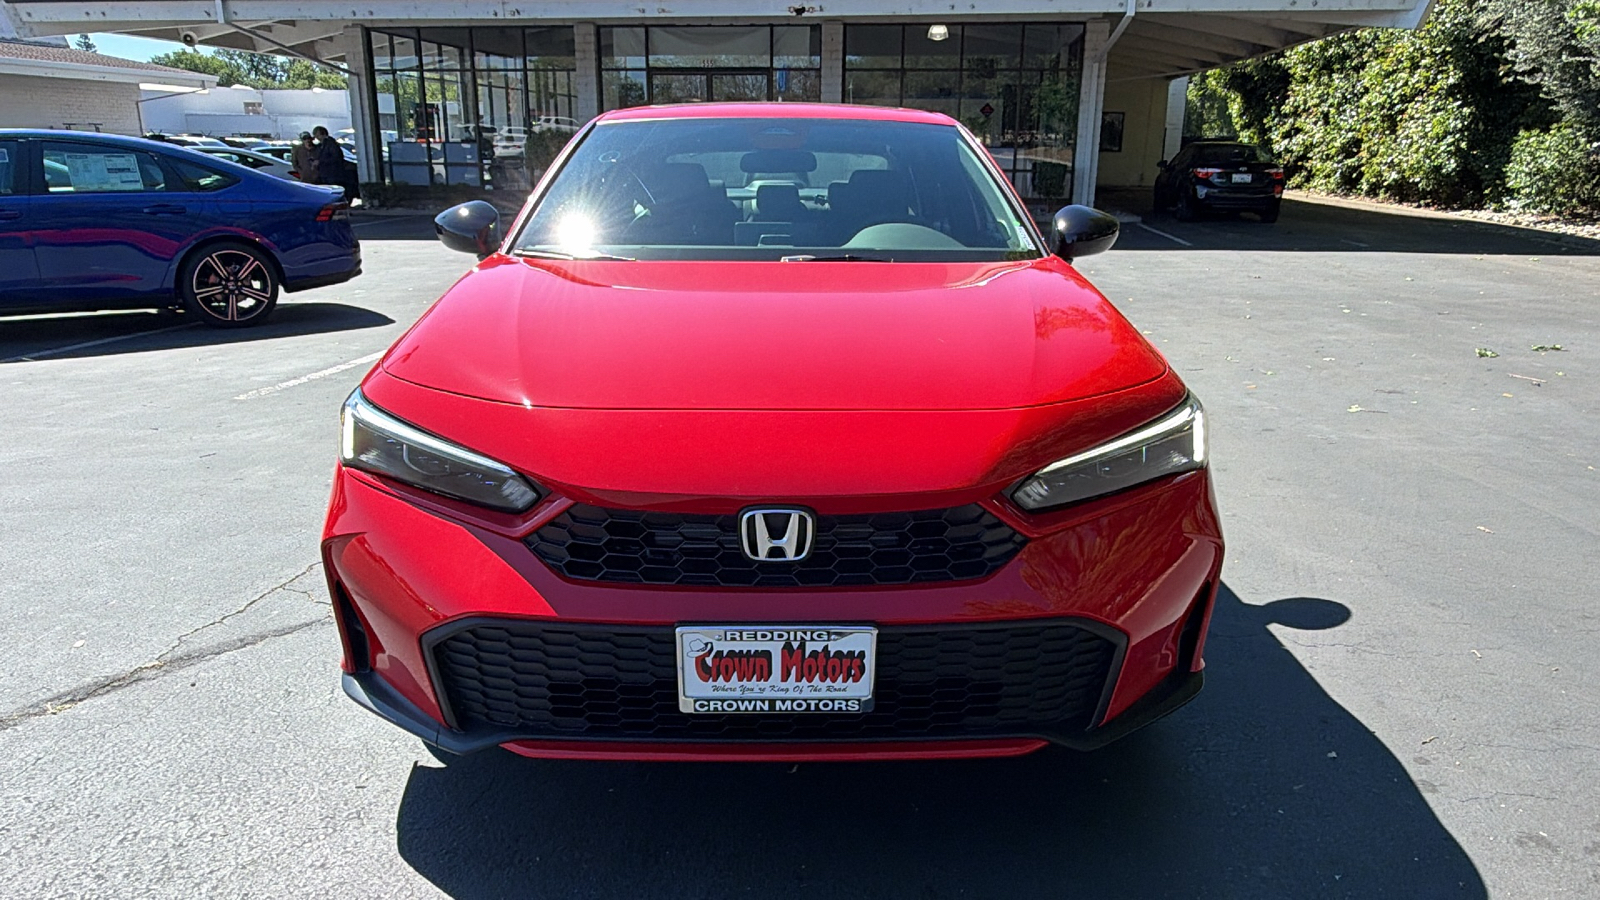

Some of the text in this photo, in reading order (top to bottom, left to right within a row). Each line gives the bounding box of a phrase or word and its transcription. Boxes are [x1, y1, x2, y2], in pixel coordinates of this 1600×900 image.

[725, 631, 829, 641] REDDING
[694, 643, 866, 684] Crown Motors
[711, 684, 848, 694] Where You're King Of The Road
[694, 700, 860, 712] CROWN MOTORS
